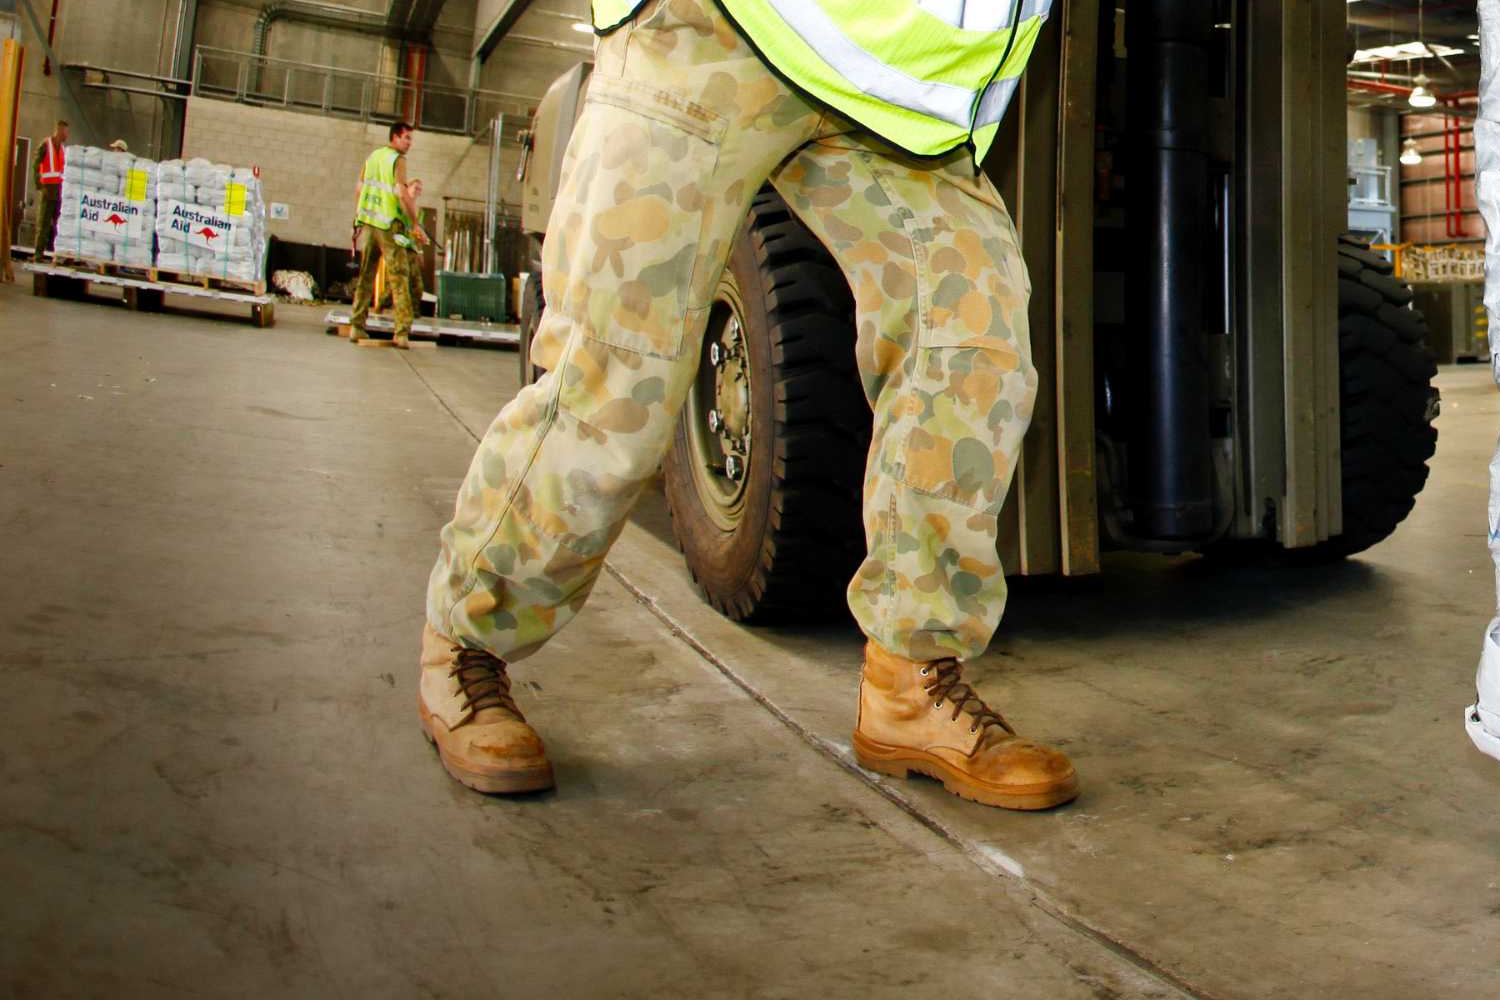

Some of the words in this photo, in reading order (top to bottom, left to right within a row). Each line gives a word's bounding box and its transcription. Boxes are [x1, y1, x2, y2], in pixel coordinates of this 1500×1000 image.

[80, 194, 139, 216] Australian
[80, 208, 100, 222] Aid
[172, 205, 232, 231] Australian
[171, 219, 191, 233] Aid
